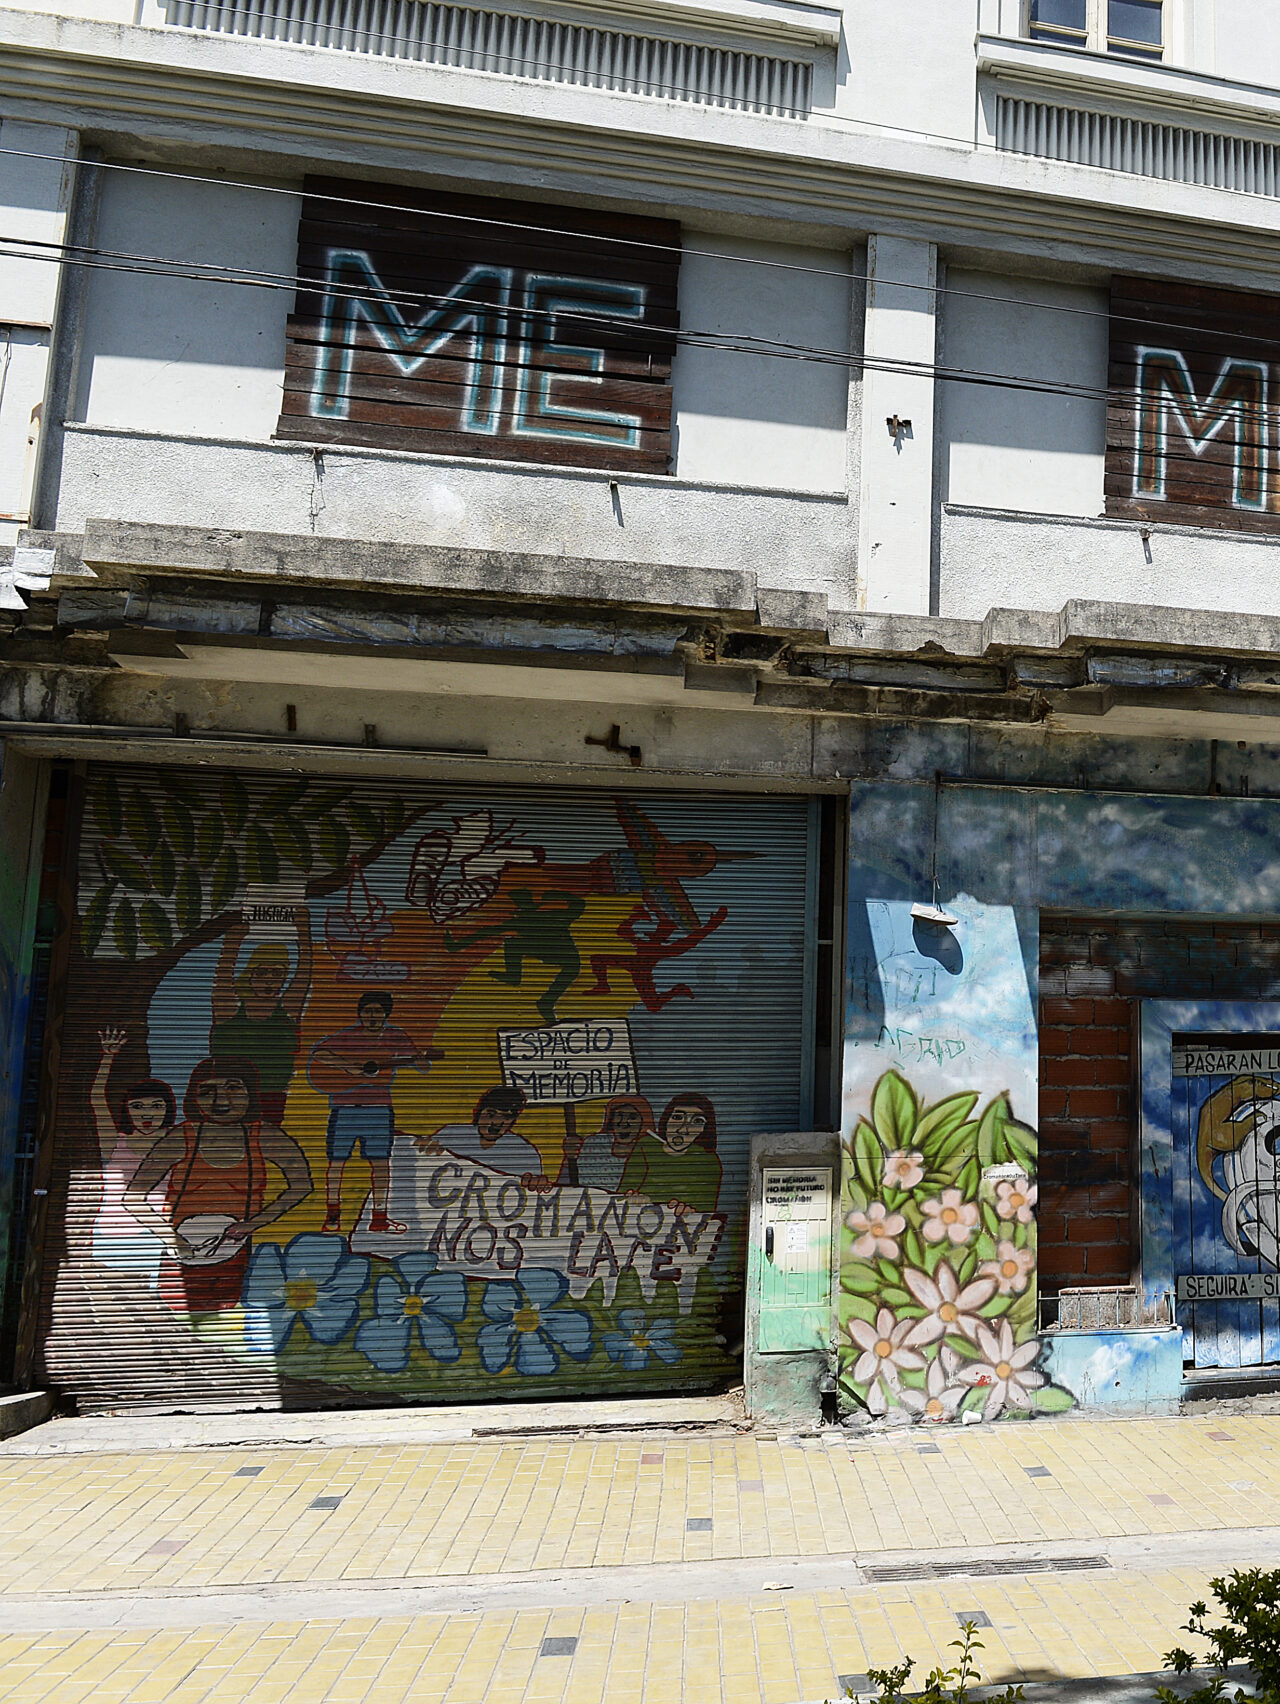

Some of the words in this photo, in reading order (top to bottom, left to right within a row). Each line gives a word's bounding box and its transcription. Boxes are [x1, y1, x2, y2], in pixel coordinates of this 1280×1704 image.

[310, 248, 647, 450] ME
[505, 1023, 613, 1060] ESPACIO
[553, 1060, 573, 1070] DE
[1184, 1053, 1262, 1073] PASARAN
[509, 1062, 631, 1100] MEMORIA
[782, 1176, 817, 1184] MEMORIA
[795, 1184, 825, 1192] FUTURO
[428, 1210, 528, 1270] NOS
